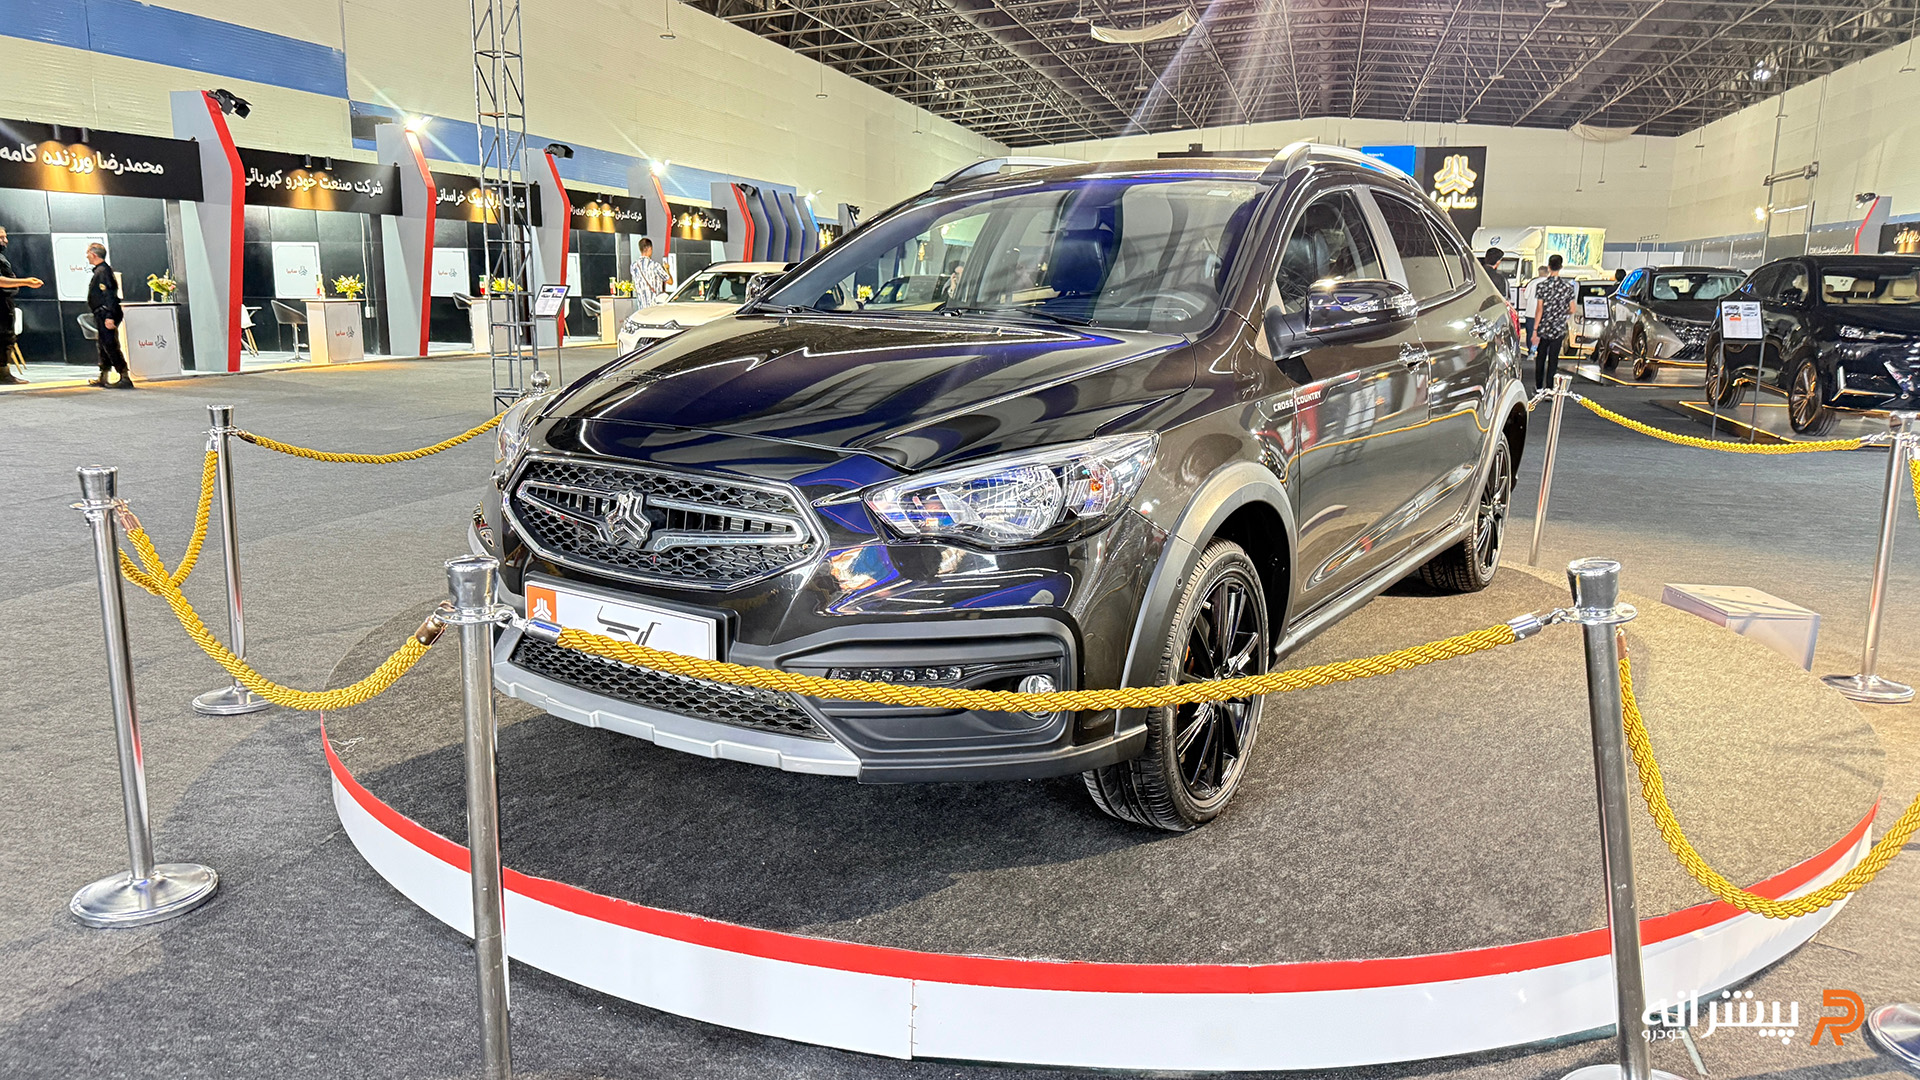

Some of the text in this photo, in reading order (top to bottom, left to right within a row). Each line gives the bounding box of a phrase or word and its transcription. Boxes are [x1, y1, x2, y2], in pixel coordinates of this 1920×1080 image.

[42, 149, 94, 174] ورزنده
[97, 151, 164, 175] محمدرضا
[285, 174, 318, 191] خودرو
[319, 175, 352, 191] صنعت
[354, 179, 384, 197] شرکت
[1272, 390, 1322, 412] CROSS COUNTRY
